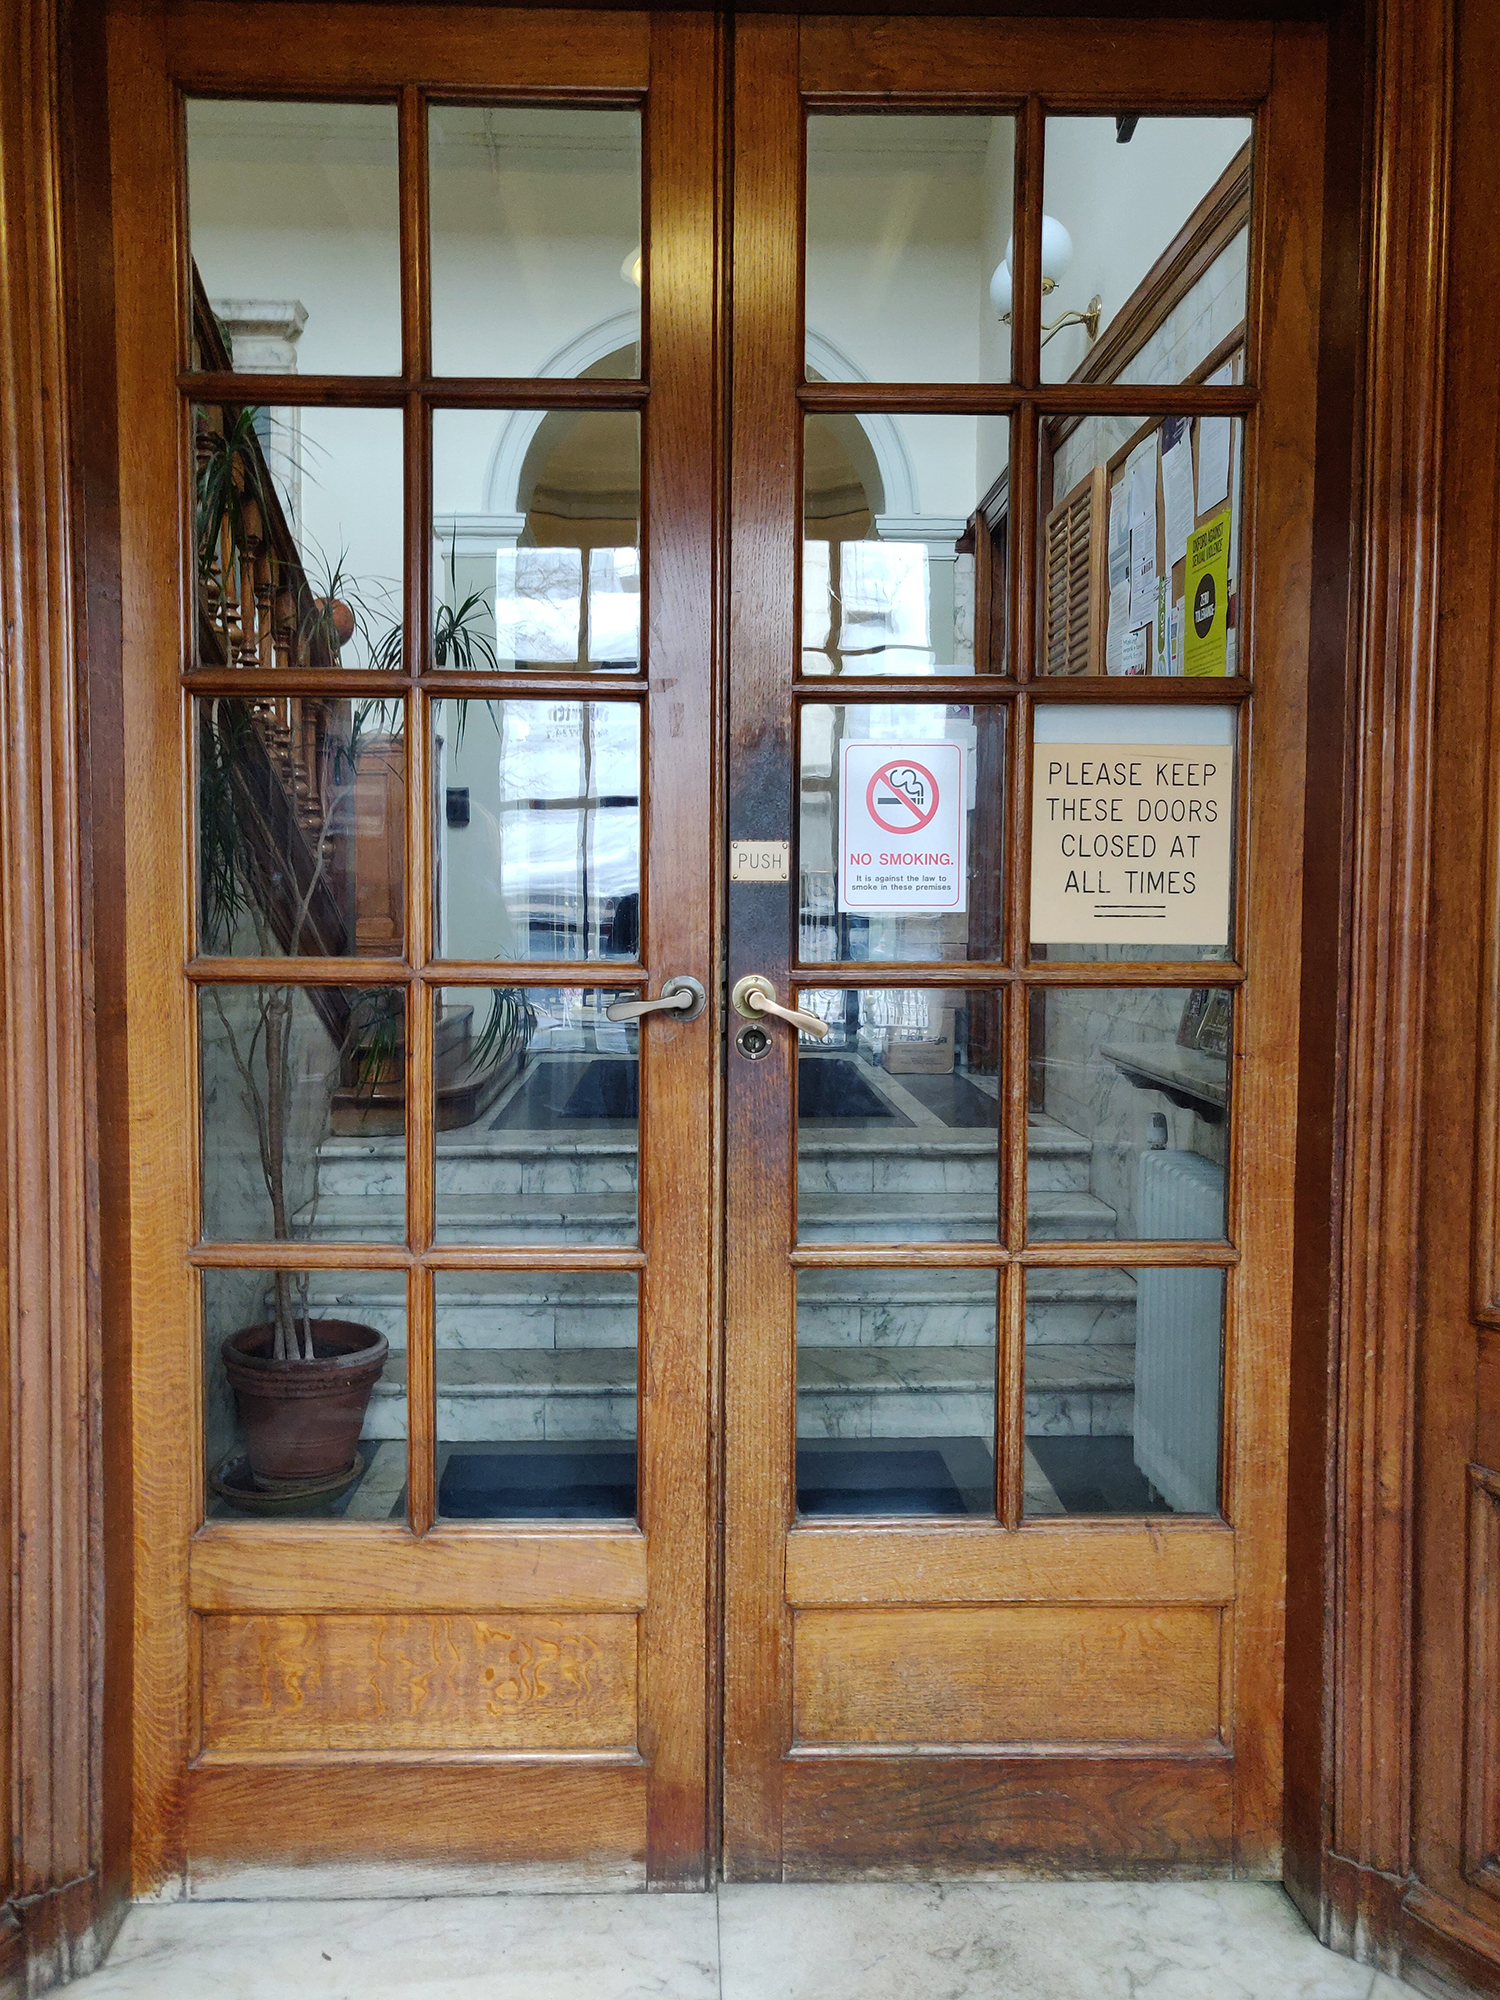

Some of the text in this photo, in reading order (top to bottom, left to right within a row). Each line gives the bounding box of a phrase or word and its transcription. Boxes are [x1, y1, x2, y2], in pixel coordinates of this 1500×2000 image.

[1049, 762, 1217, 786] PLEASE KEEP
[1046, 798, 1218, 822] THESE DOORS
[1061, 834, 1201, 858] CLOSED AT
[738, 853, 781, 869] PUSH
[850, 853, 954, 865] NO SMOKING.
[875, 875, 904, 883] against
[1064, 870, 1196, 894] ALL TIMES
